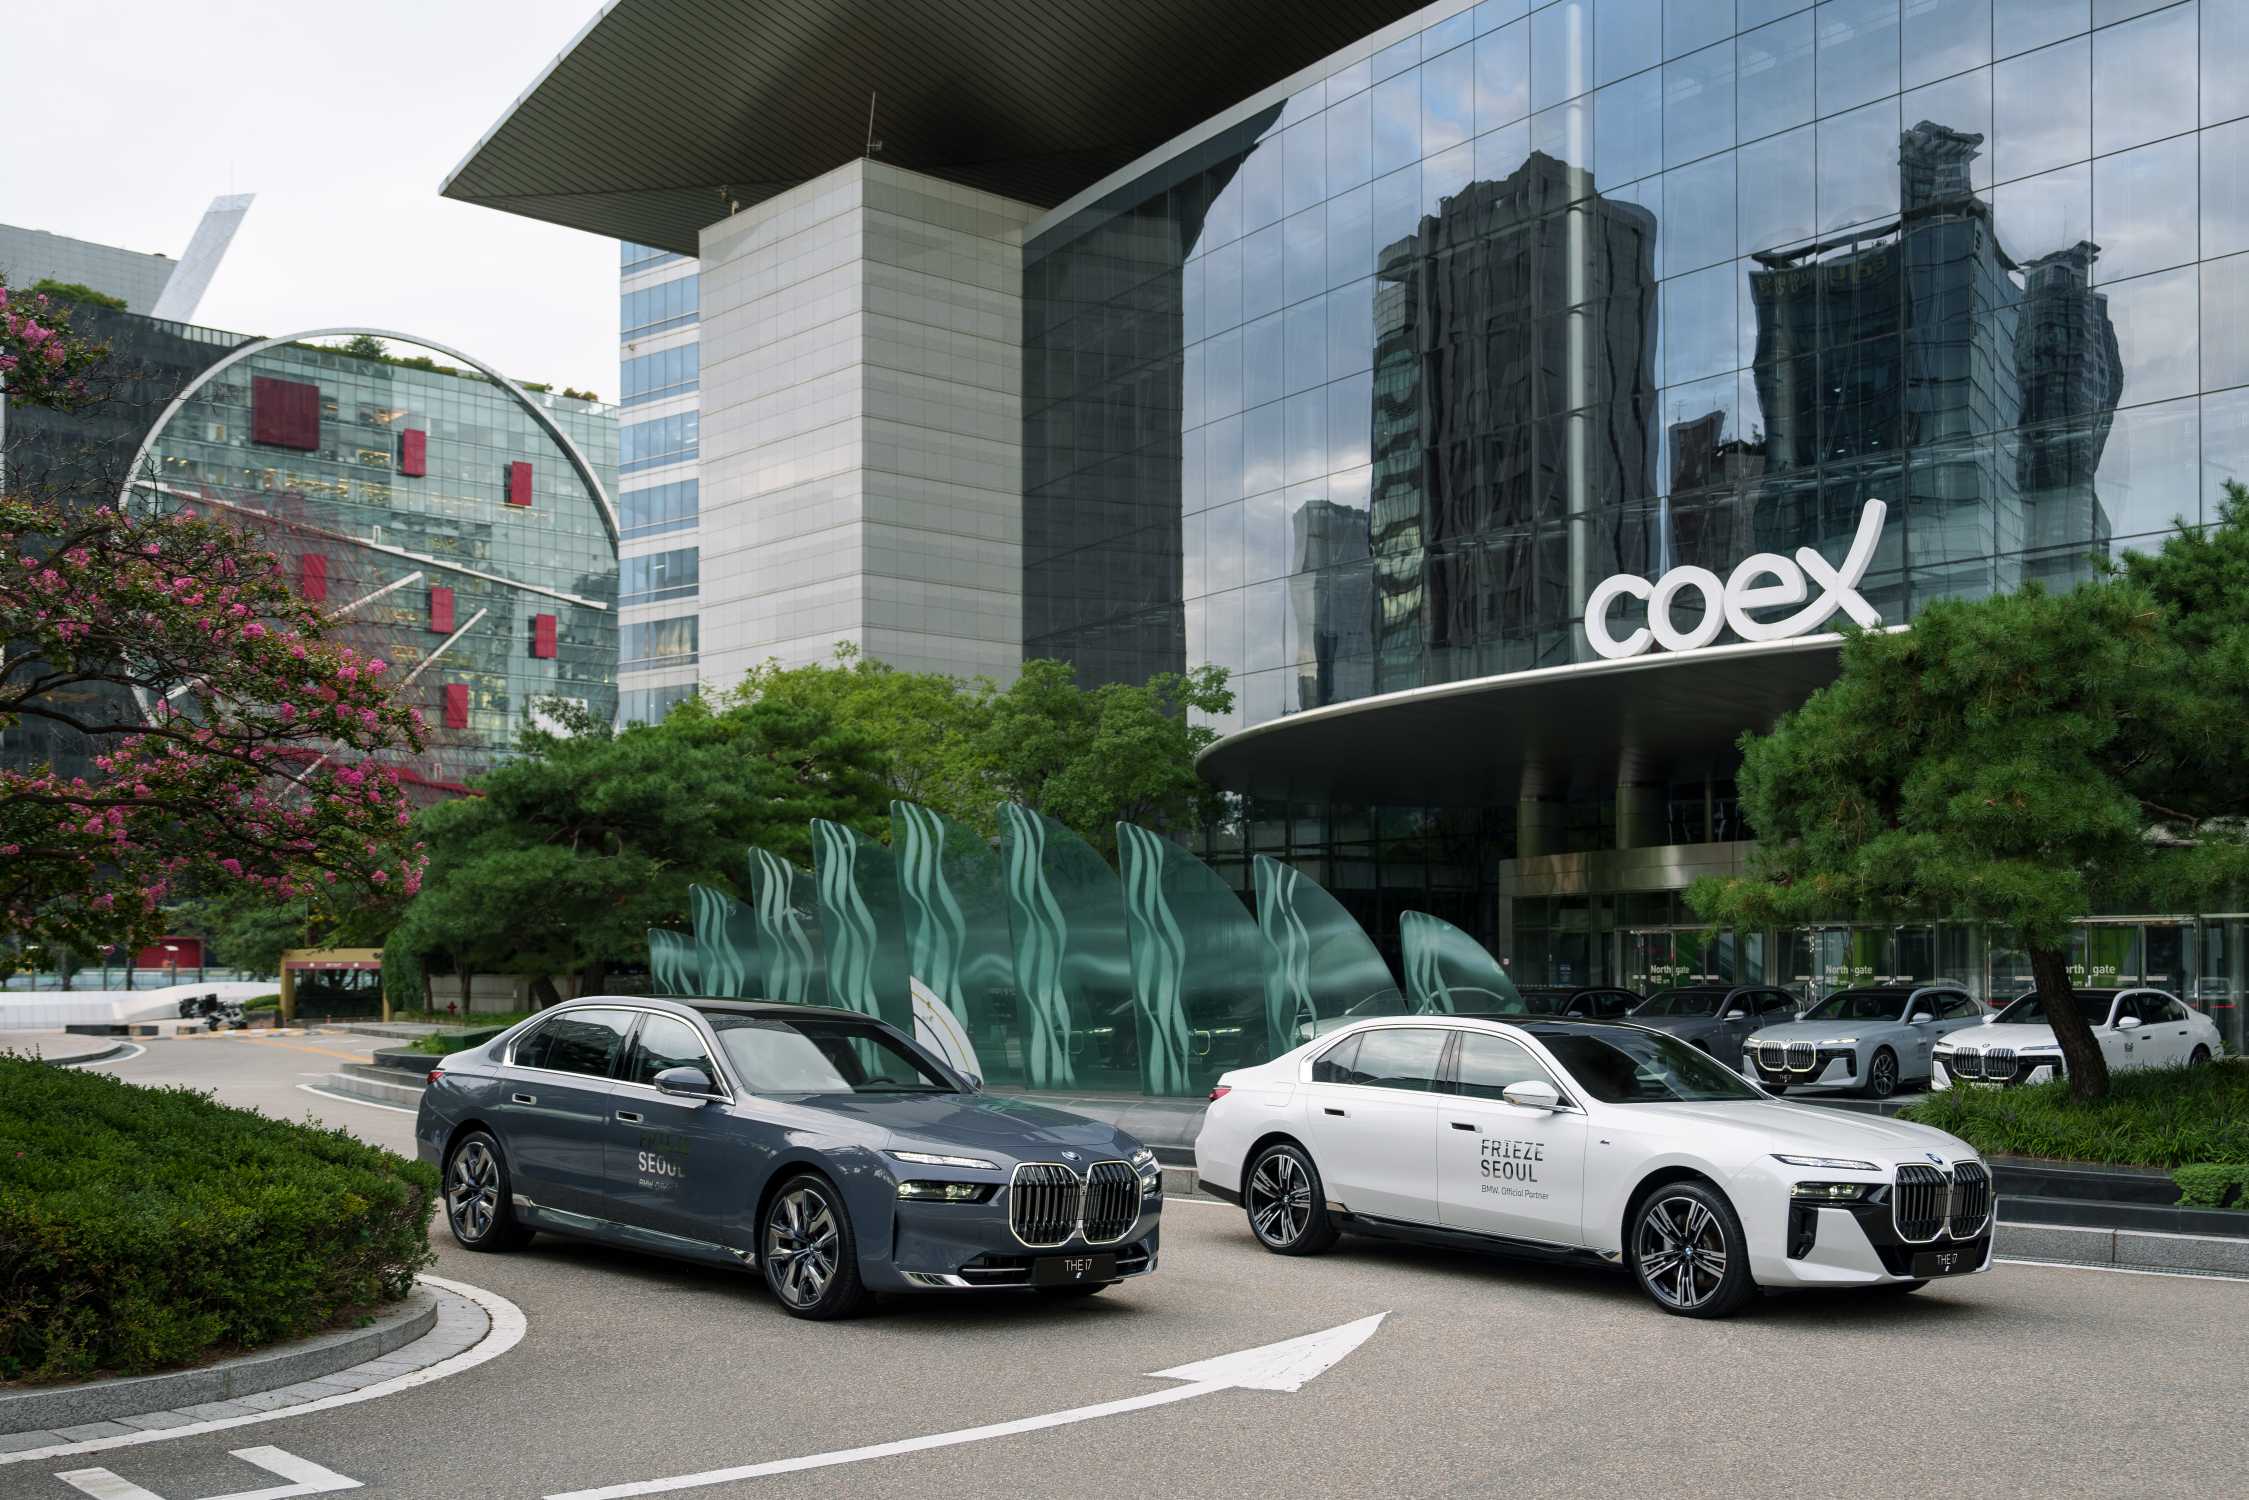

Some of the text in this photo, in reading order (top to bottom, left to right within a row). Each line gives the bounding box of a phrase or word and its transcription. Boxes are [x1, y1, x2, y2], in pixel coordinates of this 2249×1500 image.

[1584, 498, 1887, 660] coex
[1650, 964, 1690, 976] North gate
[1825, 964, 1873, 977] North gate
[2092, 964, 2116, 977] gate
[1481, 1139, 1545, 1161] FRIEZE
[1480, 1159, 1538, 1183] SEOUL
[1501, 1186, 1523, 1197] Official
[1524, 1189, 1549, 1200] Partner
[1064, 1258, 1084, 1271] THE
[1936, 1253, 1951, 1265] THE
